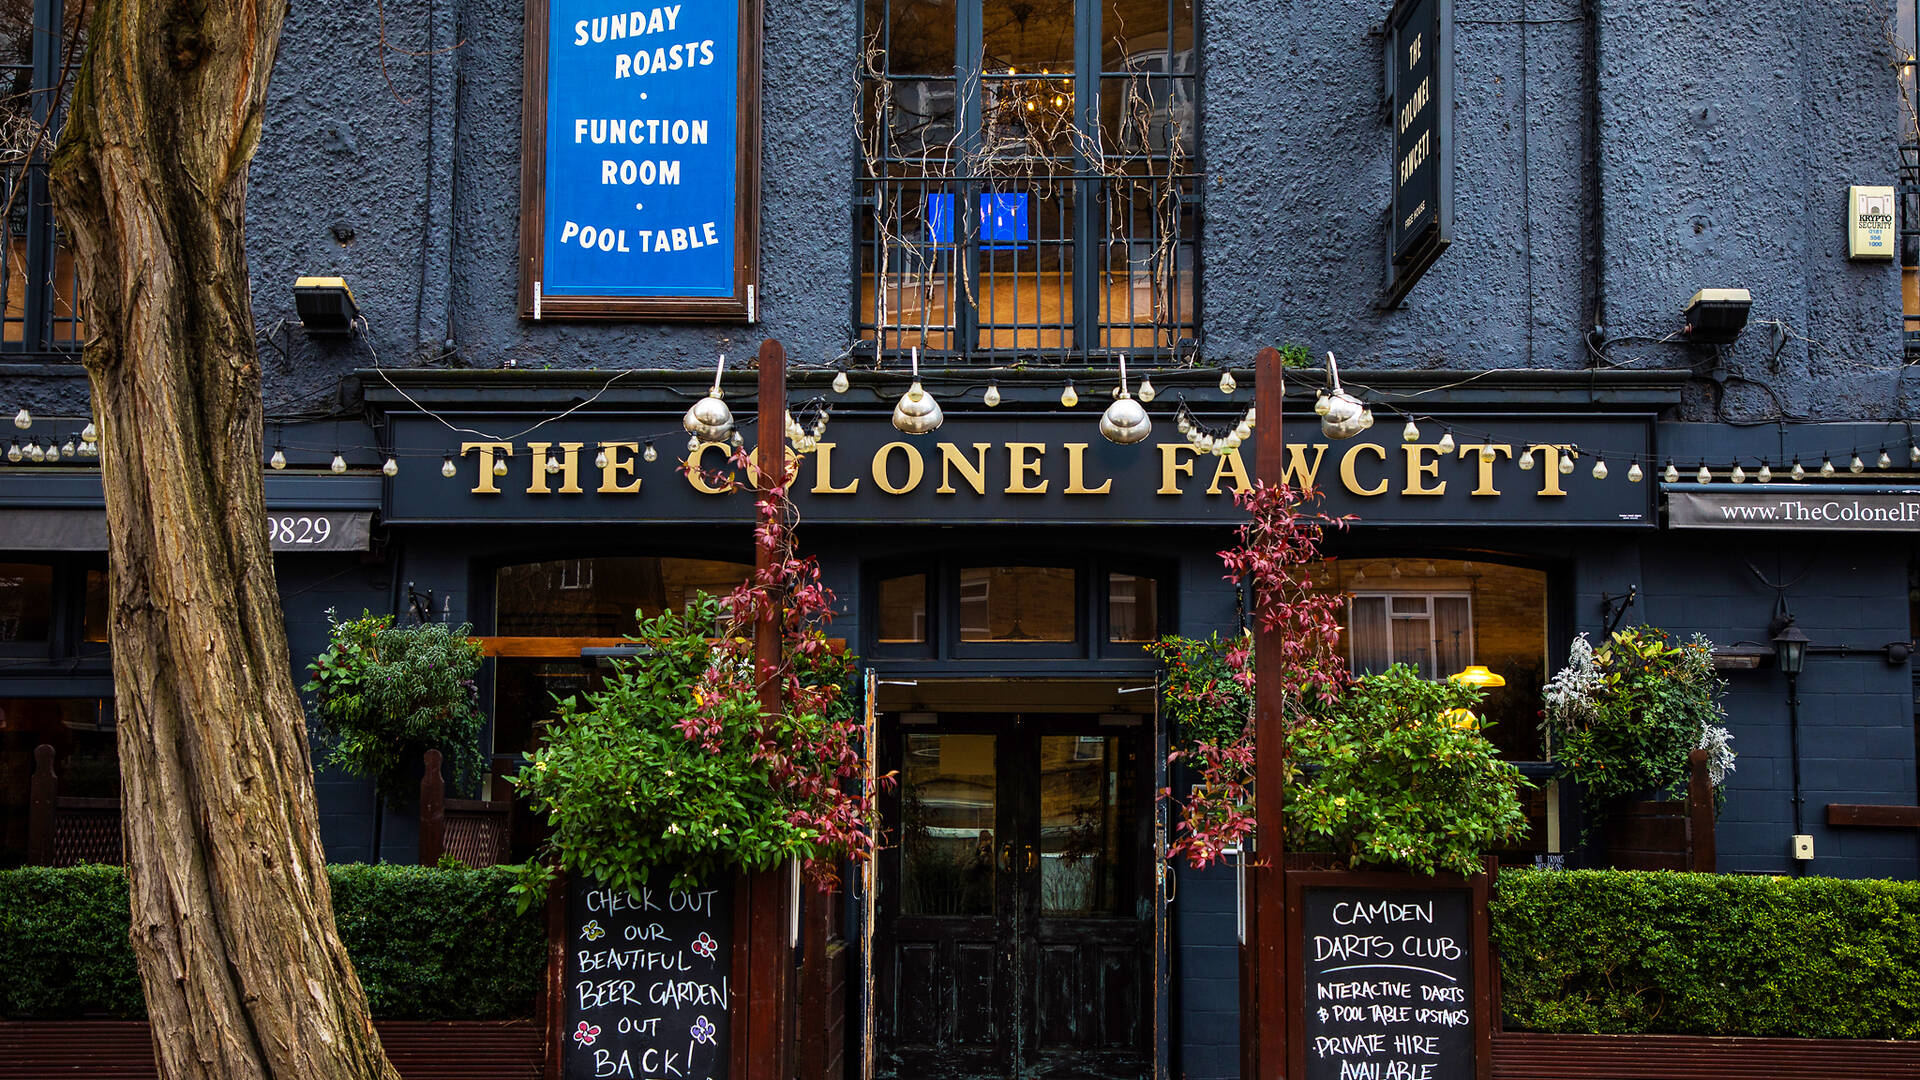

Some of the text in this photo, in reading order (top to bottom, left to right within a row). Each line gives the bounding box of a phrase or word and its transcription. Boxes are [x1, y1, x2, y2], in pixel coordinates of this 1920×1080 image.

[574, 5, 681, 46] SUNDAY
[615, 40, 715, 79] ROASTS
[1409, 33, 1422, 70] THE
[1401, 76, 1430, 134] COLONEL
[574, 119, 708, 144] FUNCTION
[1401, 129, 1430, 187] FAWCETT
[602, 160, 680, 185] ROOM
[560, 221, 719, 252] POOL TABLE
[460, 441, 643, 495] THE
[1156, 442, 1577, 497] FAWCETT
[1721, 501, 1920, 522] www.TheColonelF
[587, 887, 718, 917] CHECK OUT
[1332, 901, 1433, 925] CAMDEN
[624, 923, 672, 941] OUR
[578, 948, 691, 973] BEAUTIFUL
[1314, 934, 1461, 962] DARTS CLUB
[576, 975, 728, 1010] BEER GARDEN
[1317, 981, 1465, 1003] INTERACTIVE DARTS
[618, 1016, 661, 1037] OUT
[1332, 1005, 1367, 1023] POOL
[1368, 1004, 1412, 1026] TABLE
[1416, 1009, 1469, 1028] UPSTAIRS
[1315, 1034, 1440, 1058] PRIVATE HIRE
[593, 1040, 696, 1079] BACK!
[1340, 1059, 1438, 1080] AVAILABLE
